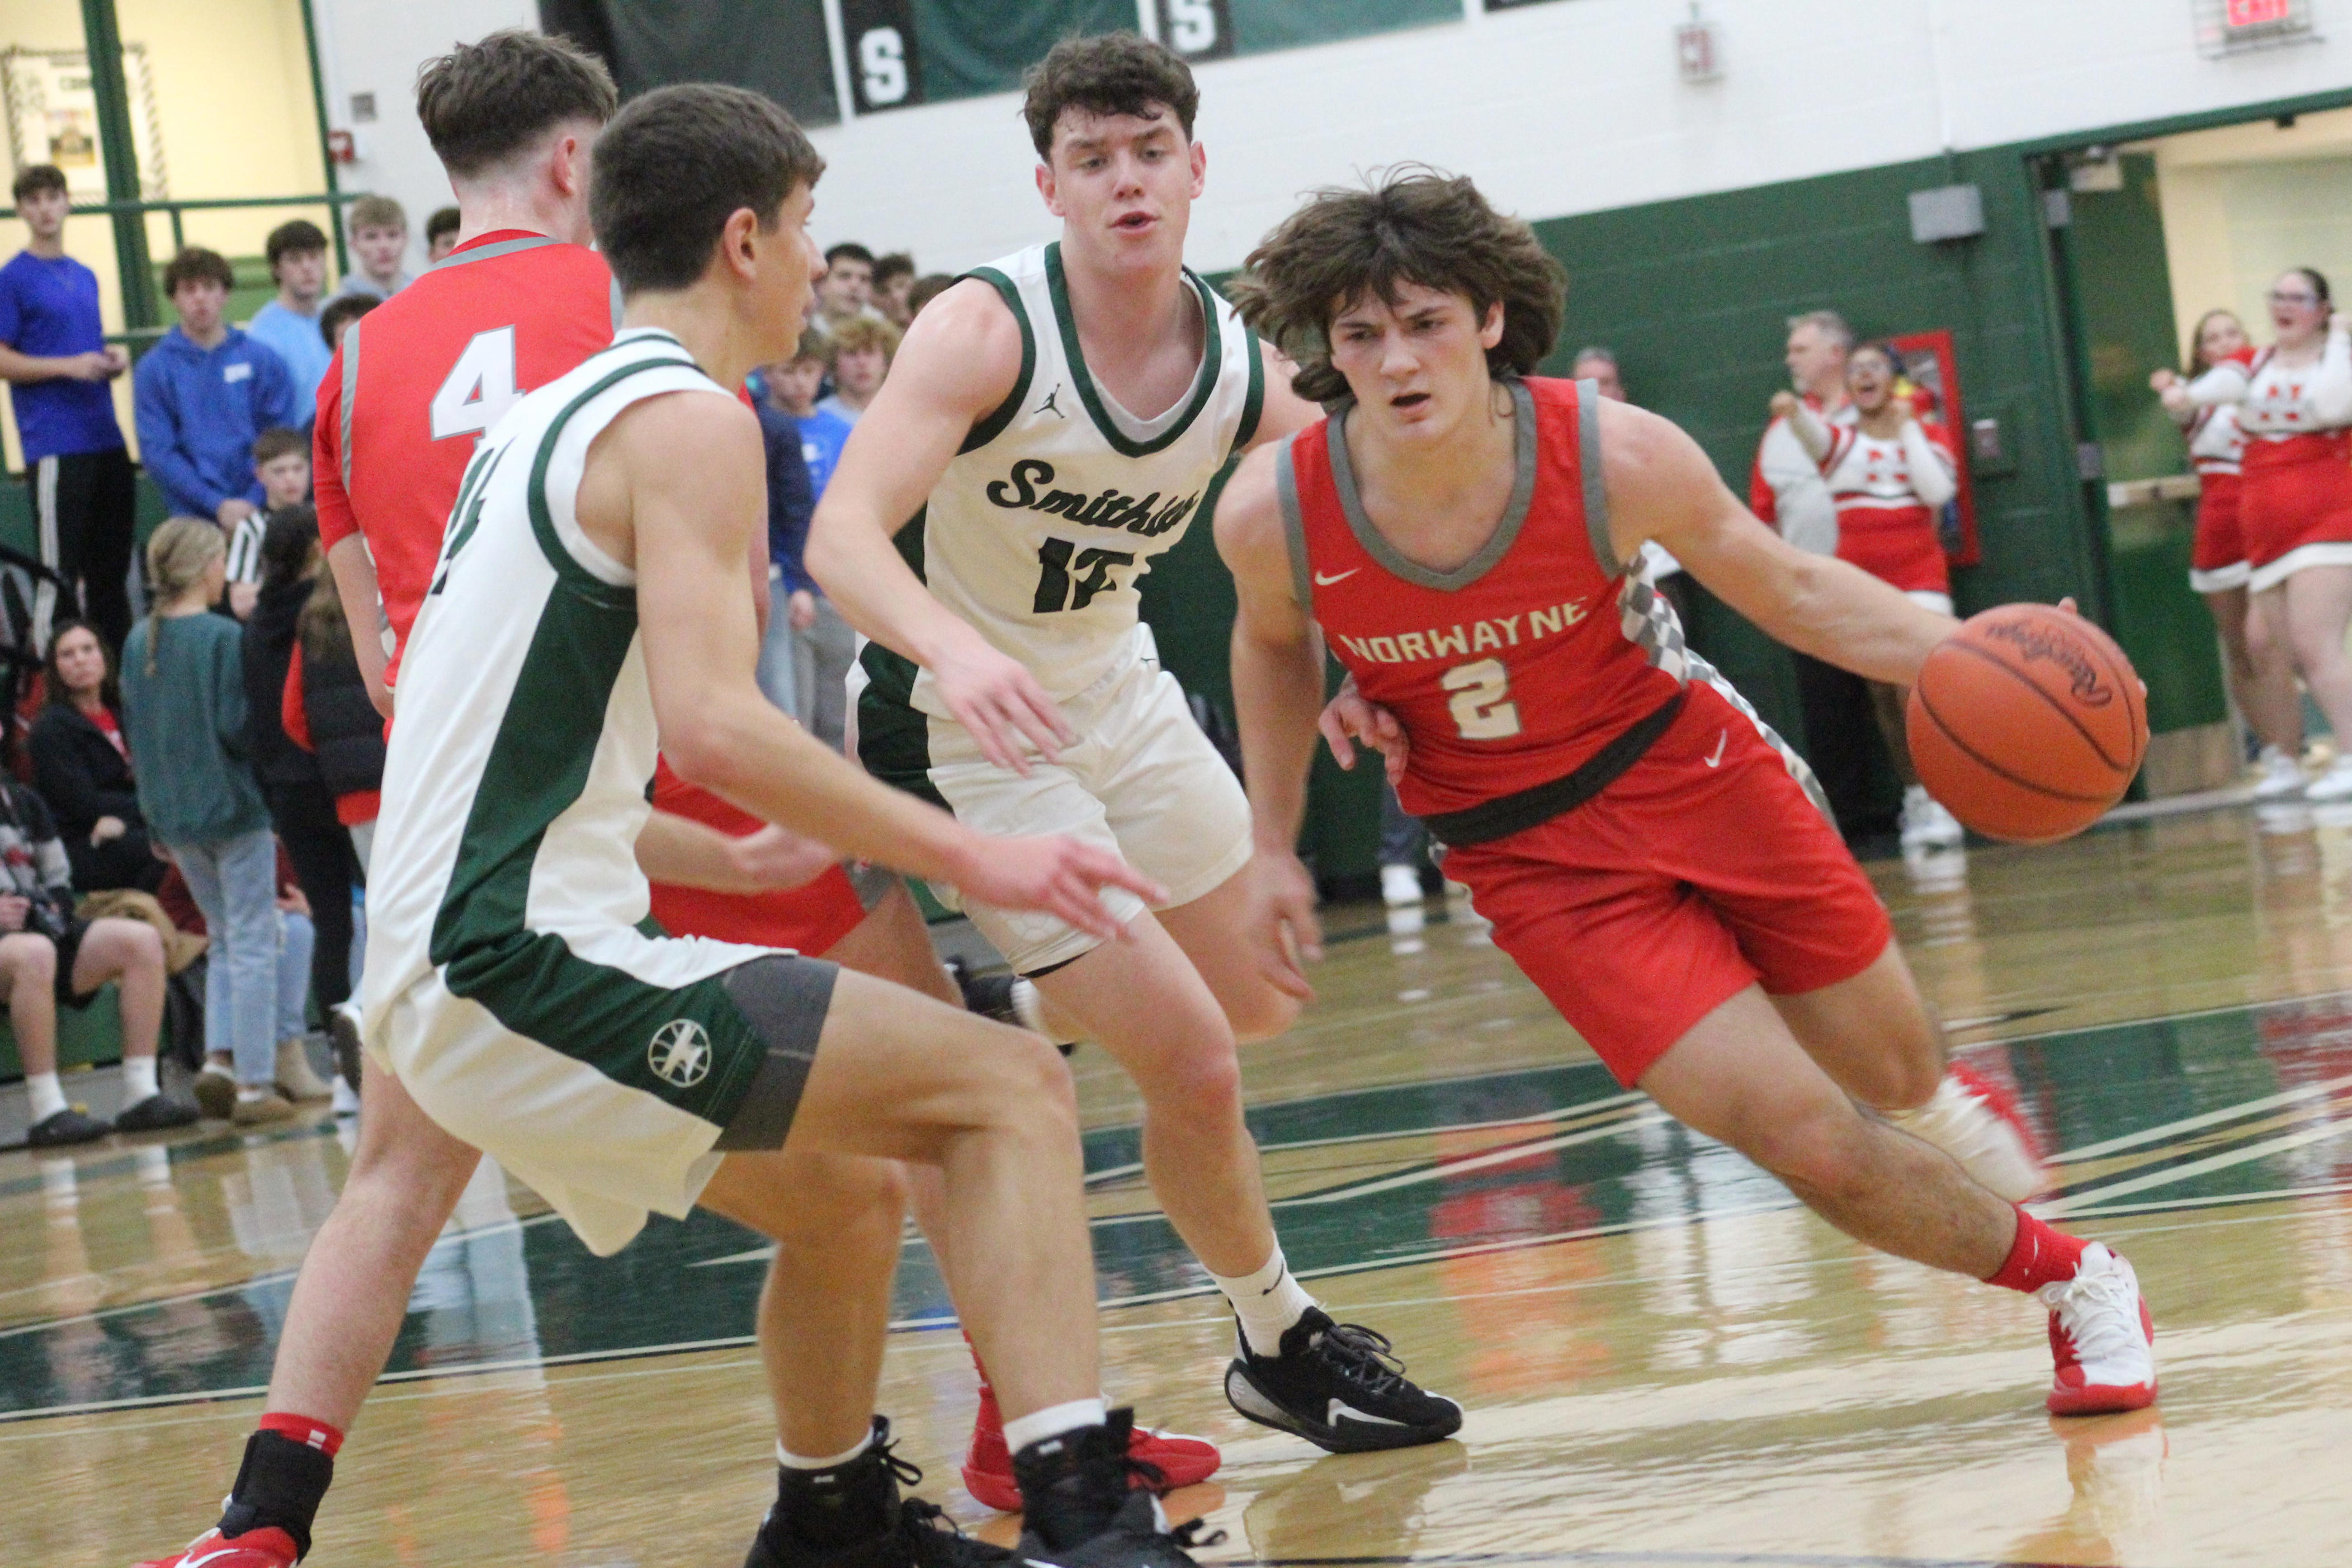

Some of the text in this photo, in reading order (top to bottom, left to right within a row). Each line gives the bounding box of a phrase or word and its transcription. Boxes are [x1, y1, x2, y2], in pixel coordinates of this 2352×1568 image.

[859, 27, 908, 105] S
[429, 324, 526, 447] 4
[1338, 596, 1588, 663] NORWAYNE
[1439, 657, 1522, 741] 2
